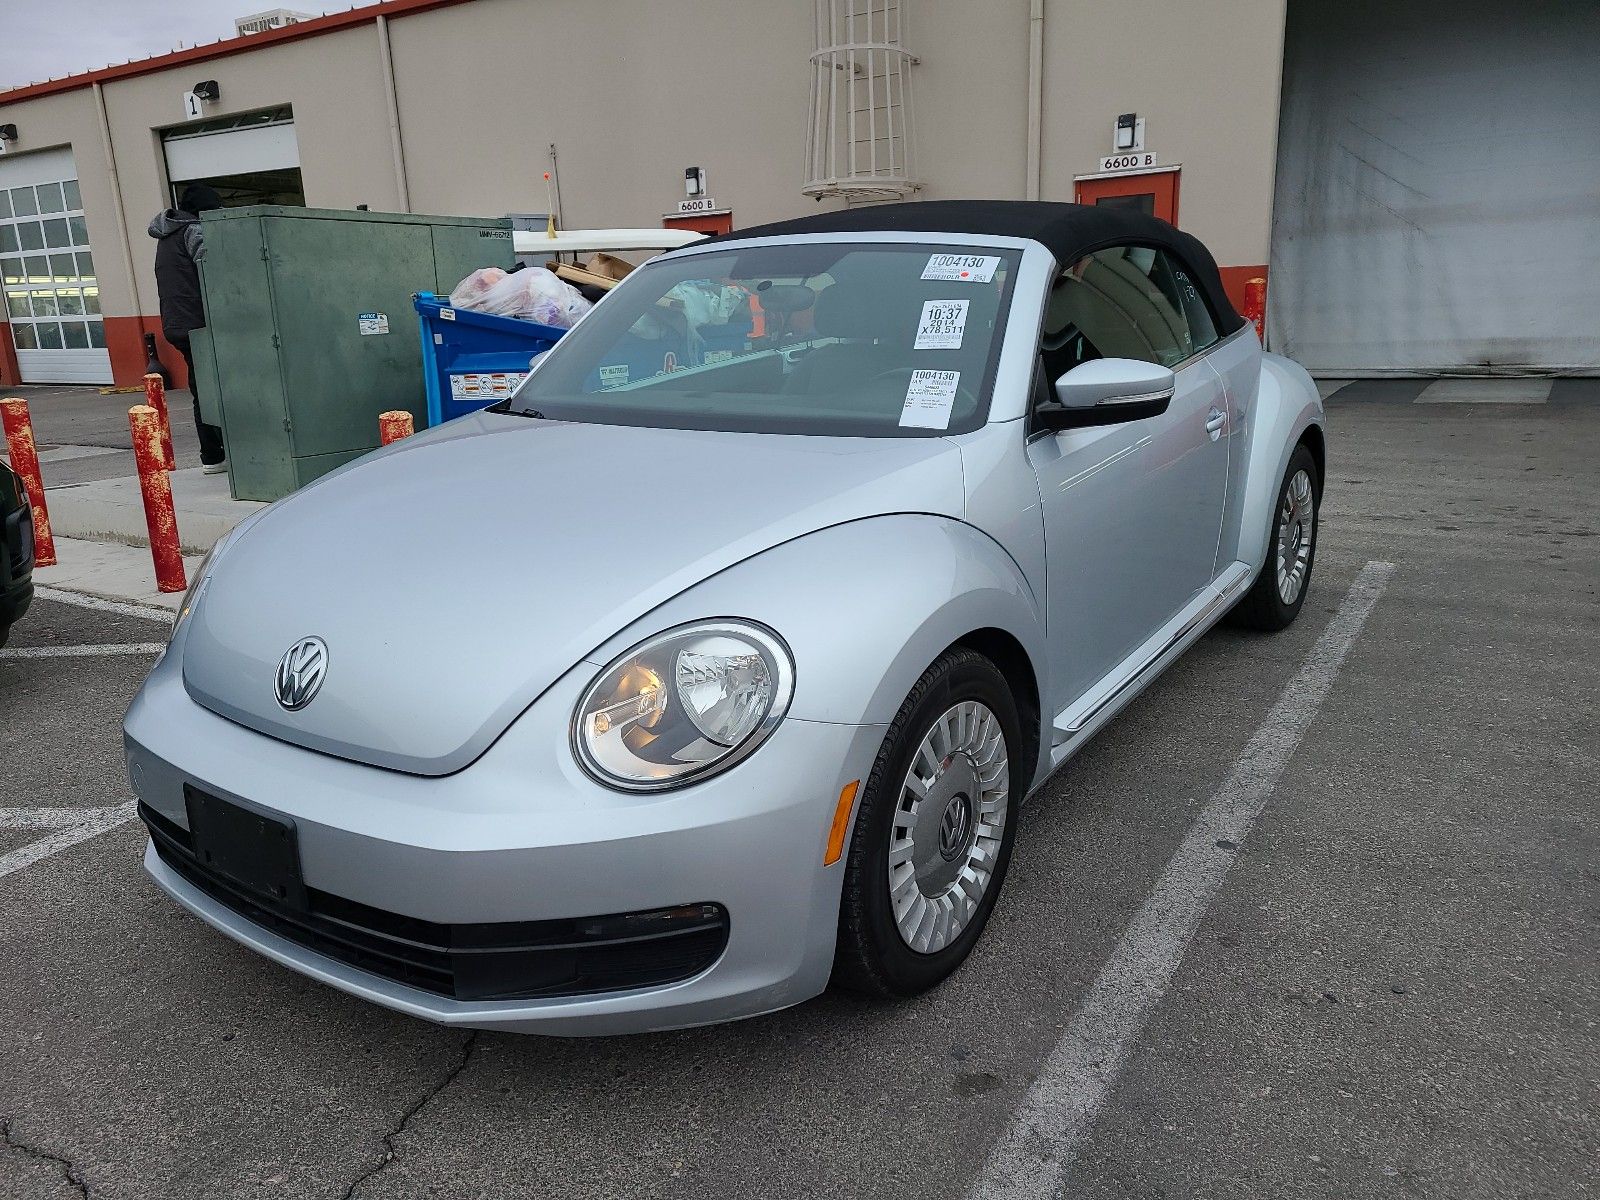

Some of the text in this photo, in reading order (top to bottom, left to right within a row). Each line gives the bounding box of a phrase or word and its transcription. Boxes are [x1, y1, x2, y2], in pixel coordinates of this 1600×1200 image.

[189, 95, 198, 116] 1
[1104, 154, 1153, 169] 6600 B
[681, 200, 713, 211] 6600 B
[932, 255, 985, 268] 1004130
[928, 308, 962, 321] 10:37
[930, 319, 955, 328] 2014
[921, 325, 963, 336] X78,511
[914, 371, 955, 381] 1004130
